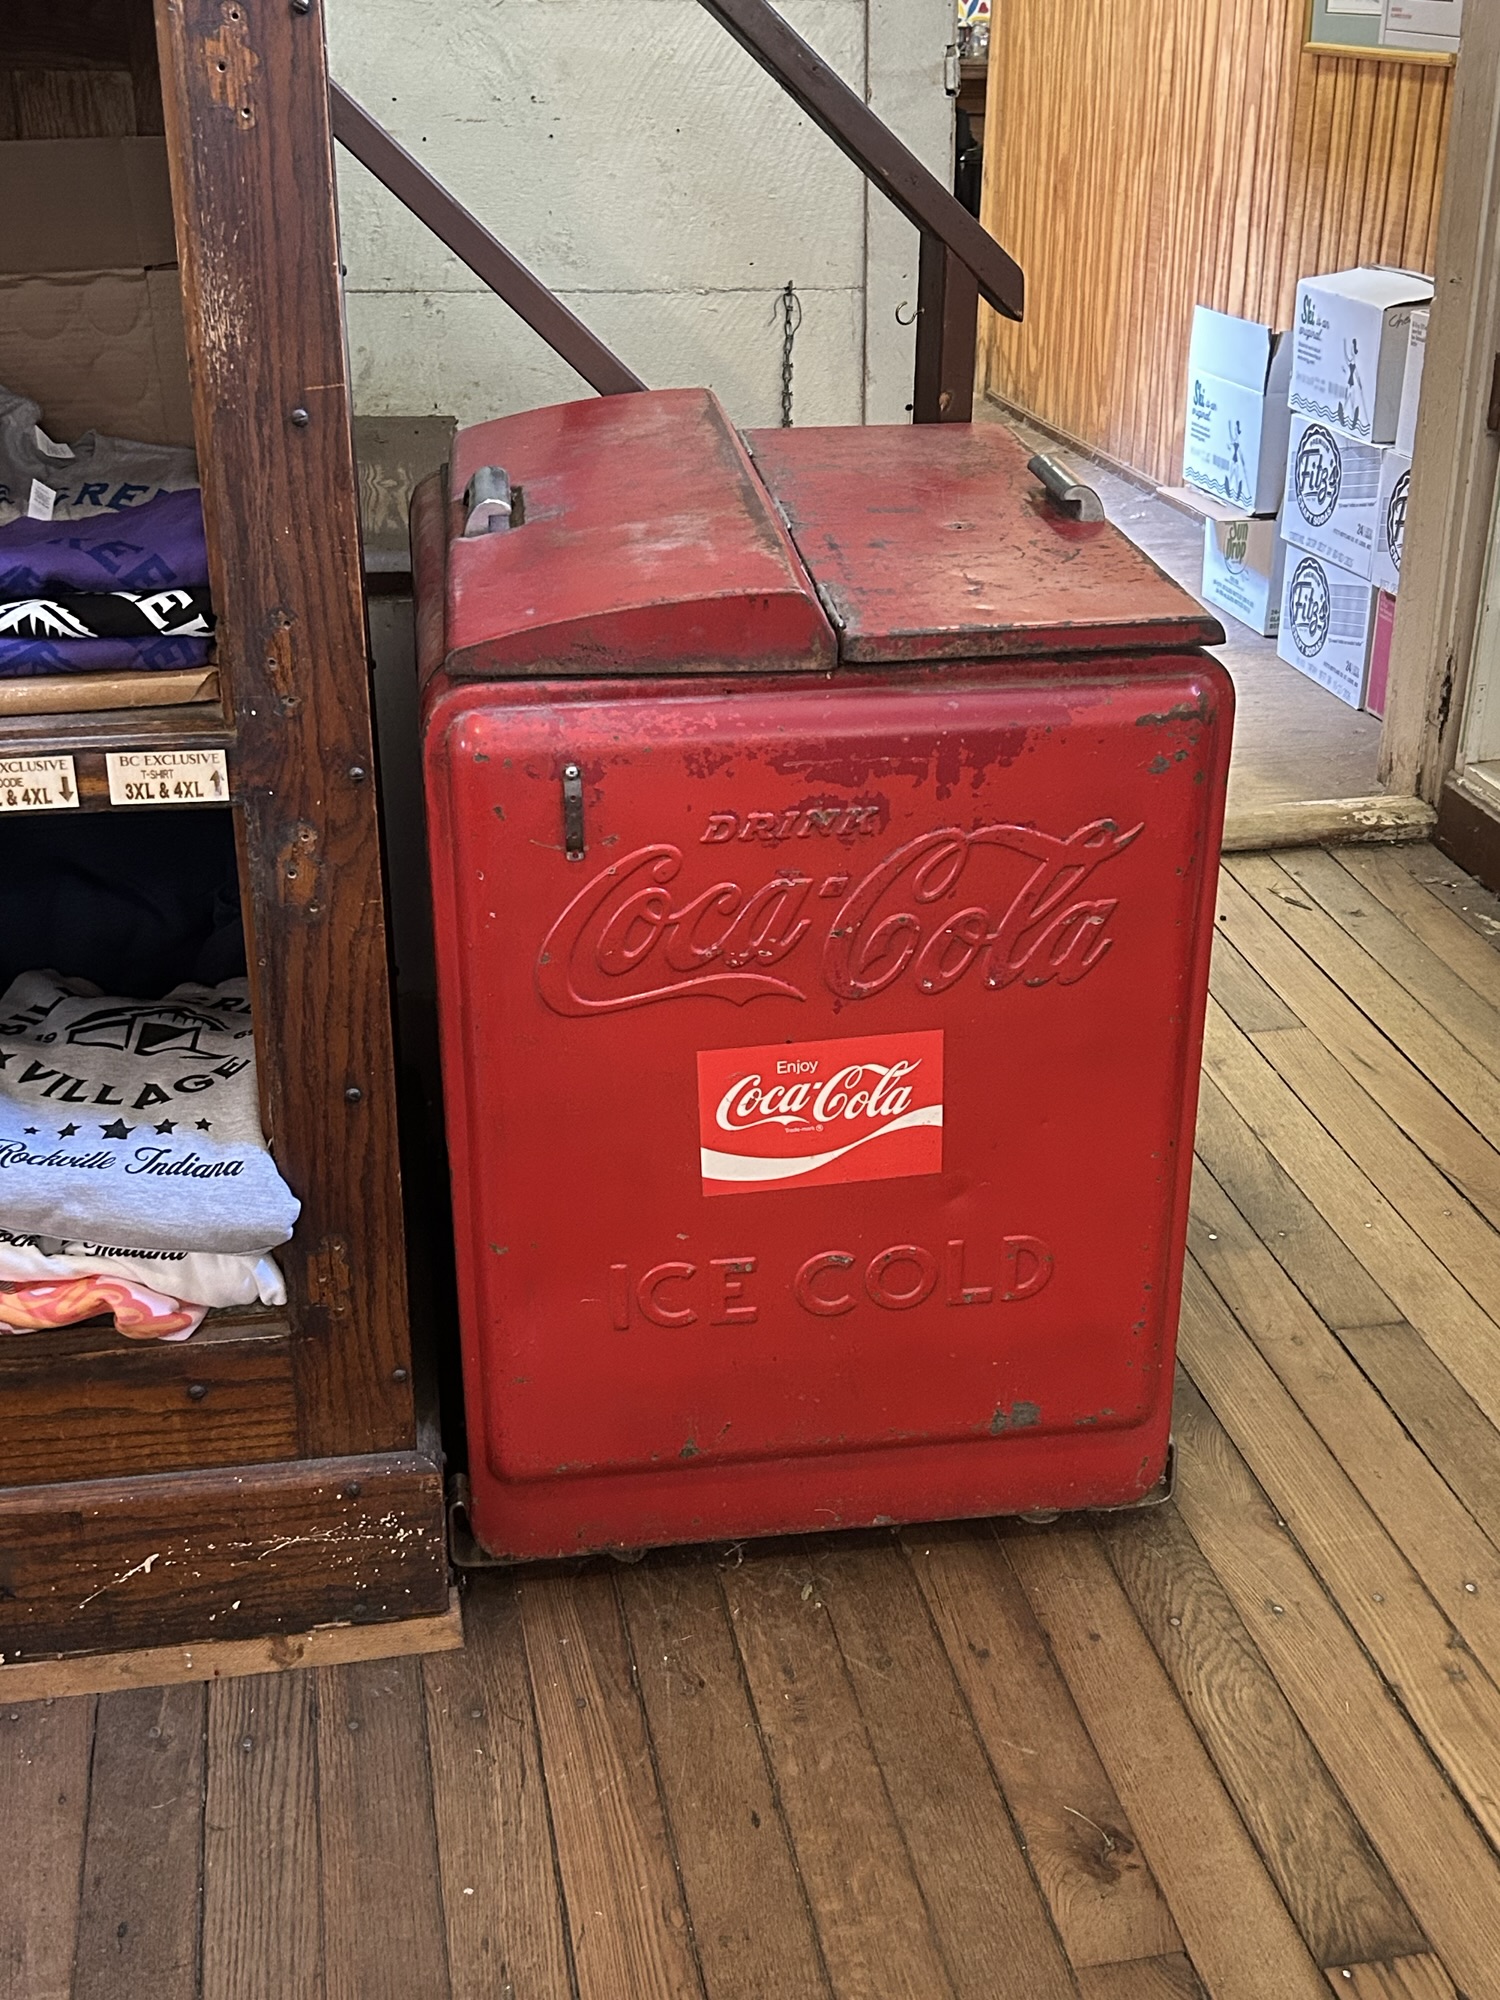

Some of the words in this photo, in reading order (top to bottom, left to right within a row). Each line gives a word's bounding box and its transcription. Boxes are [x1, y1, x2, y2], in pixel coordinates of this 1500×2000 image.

[1301, 294, 1315, 326] Ski
[119, 755, 140, 767] BC
[144, 753, 220, 766] EXCLUSIVE
[140, 769, 174, 780] T-SHIRT
[7, 789, 18, 807] &
[22, 787, 53, 806] 4XL
[125, 783, 155, 800] 3XL
[159, 782, 170, 799] &
[174, 781, 204, 799] 4XL
[699, 805, 882, 844] DRINK
[534, 817, 1146, 1019] Coca-Cola
[35, 1032, 57, 1043] 19
[18, 1056, 251, 1110] VILLAGE
[776, 1059, 819, 1075] Enjoy
[716, 1058, 923, 1131] Coca-Cola
[0, 1139, 118, 1170] Rockville
[125, 1147, 245, 1178] Indiana
[609, 1255, 759, 1331] ICE
[793, 1234, 1056, 1318] COLD
